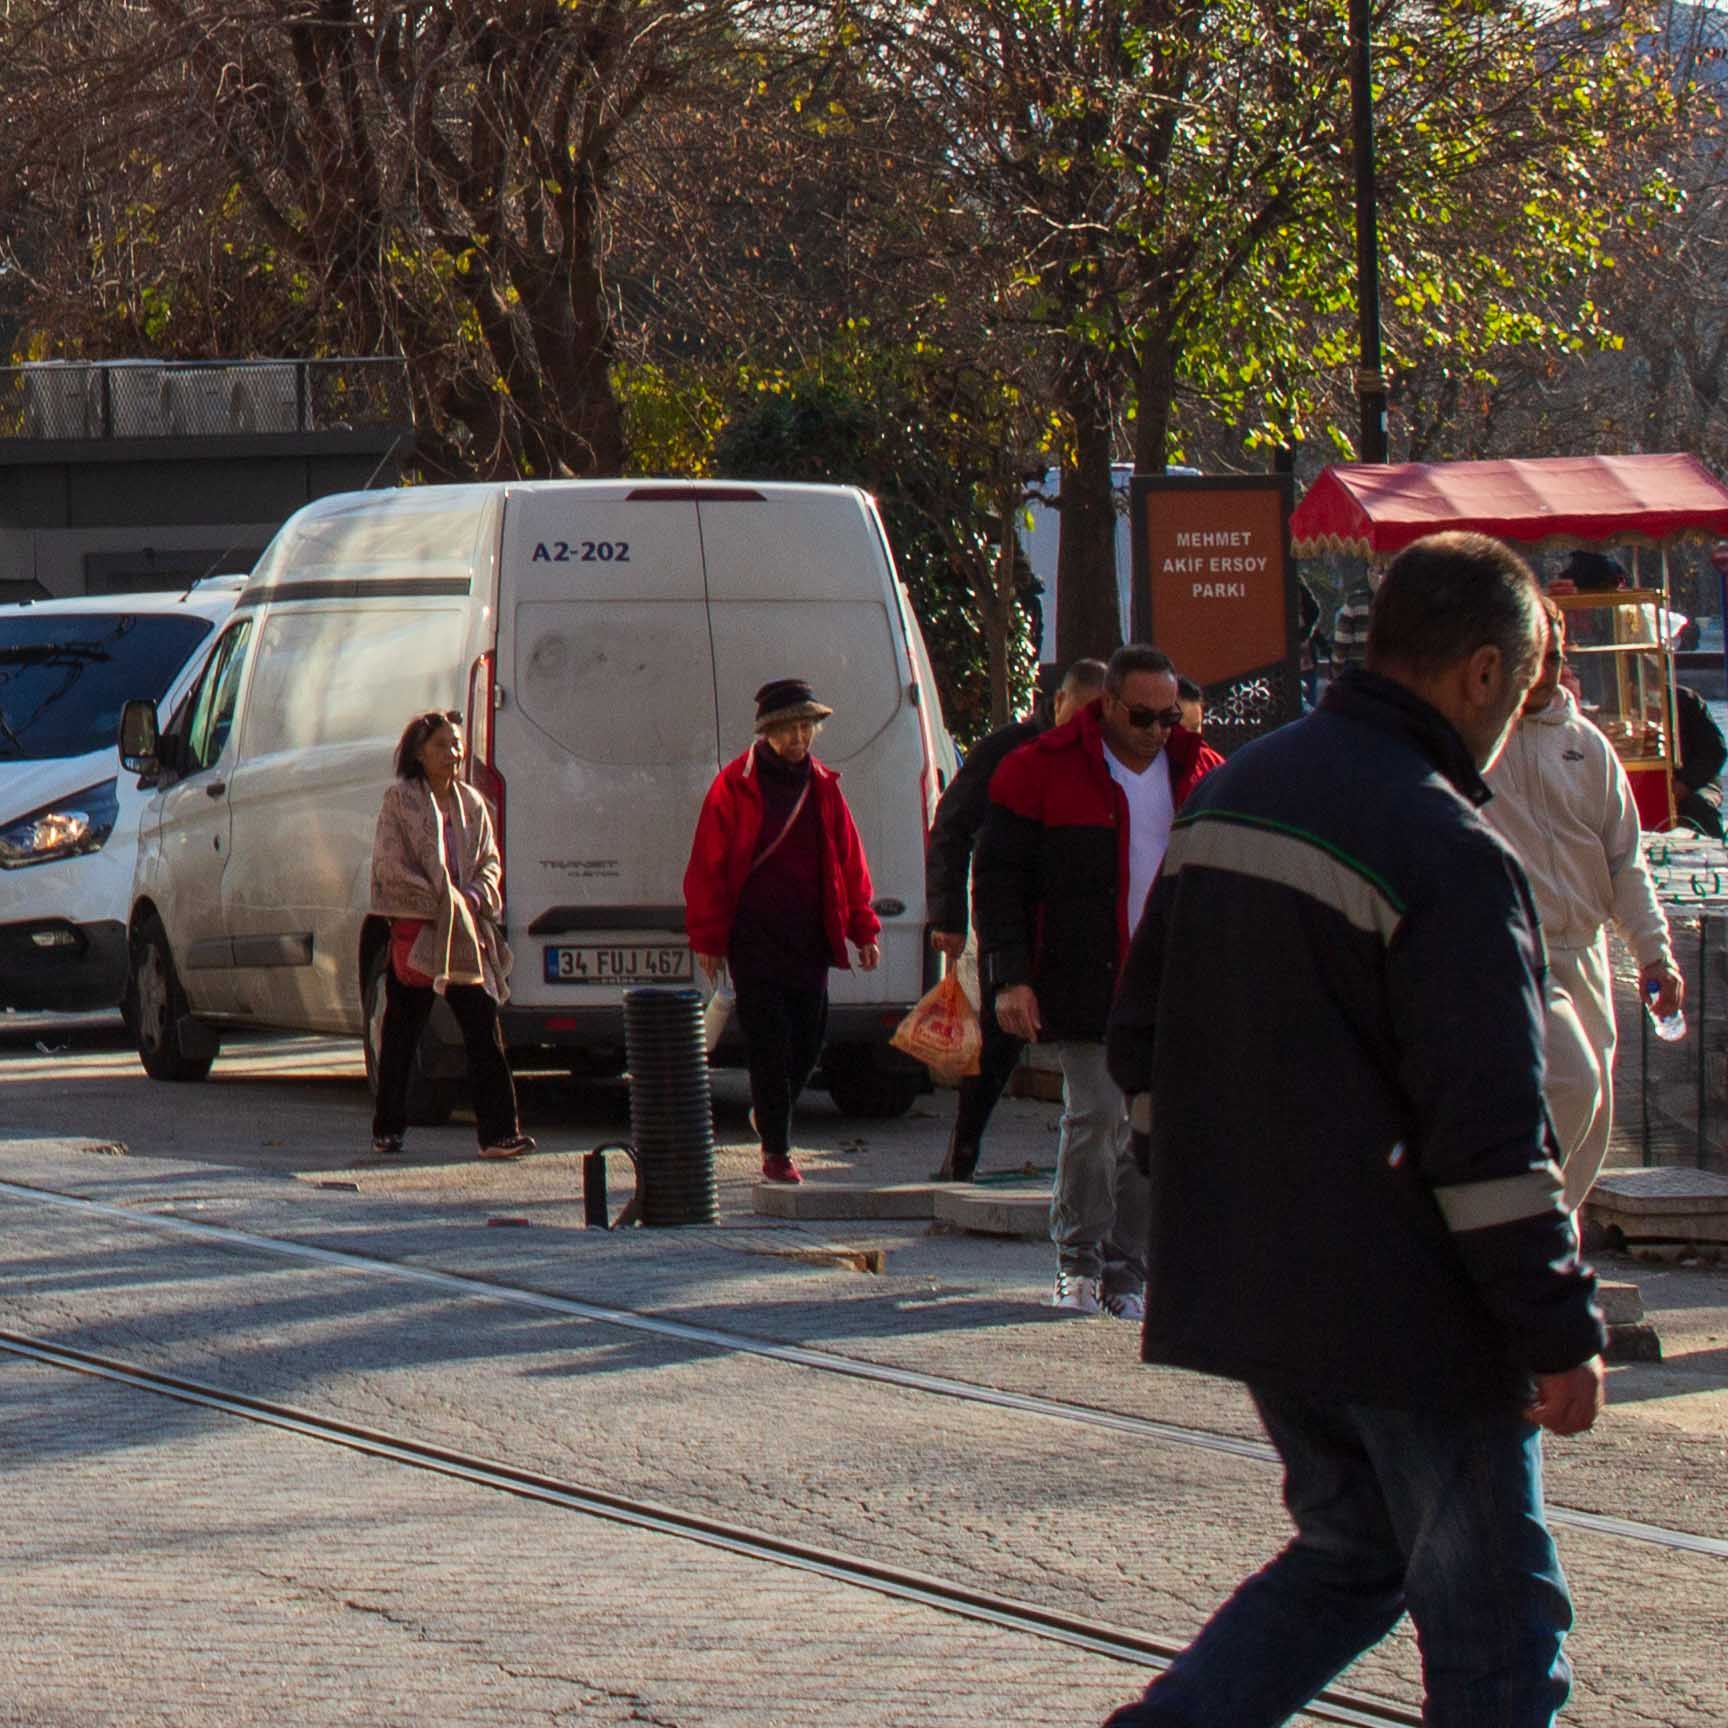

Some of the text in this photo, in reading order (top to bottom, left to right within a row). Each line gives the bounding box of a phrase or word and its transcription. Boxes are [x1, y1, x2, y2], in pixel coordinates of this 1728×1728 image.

[1176, 531, 1252, 547] MEHMET
[531, 541, 631, 562] A2-202
[1163, 555, 1268, 573] AKİF ERSOY
[1191, 582, 1246, 598] PARKI
[561, 951, 685, 976] 34 FUJ 467
